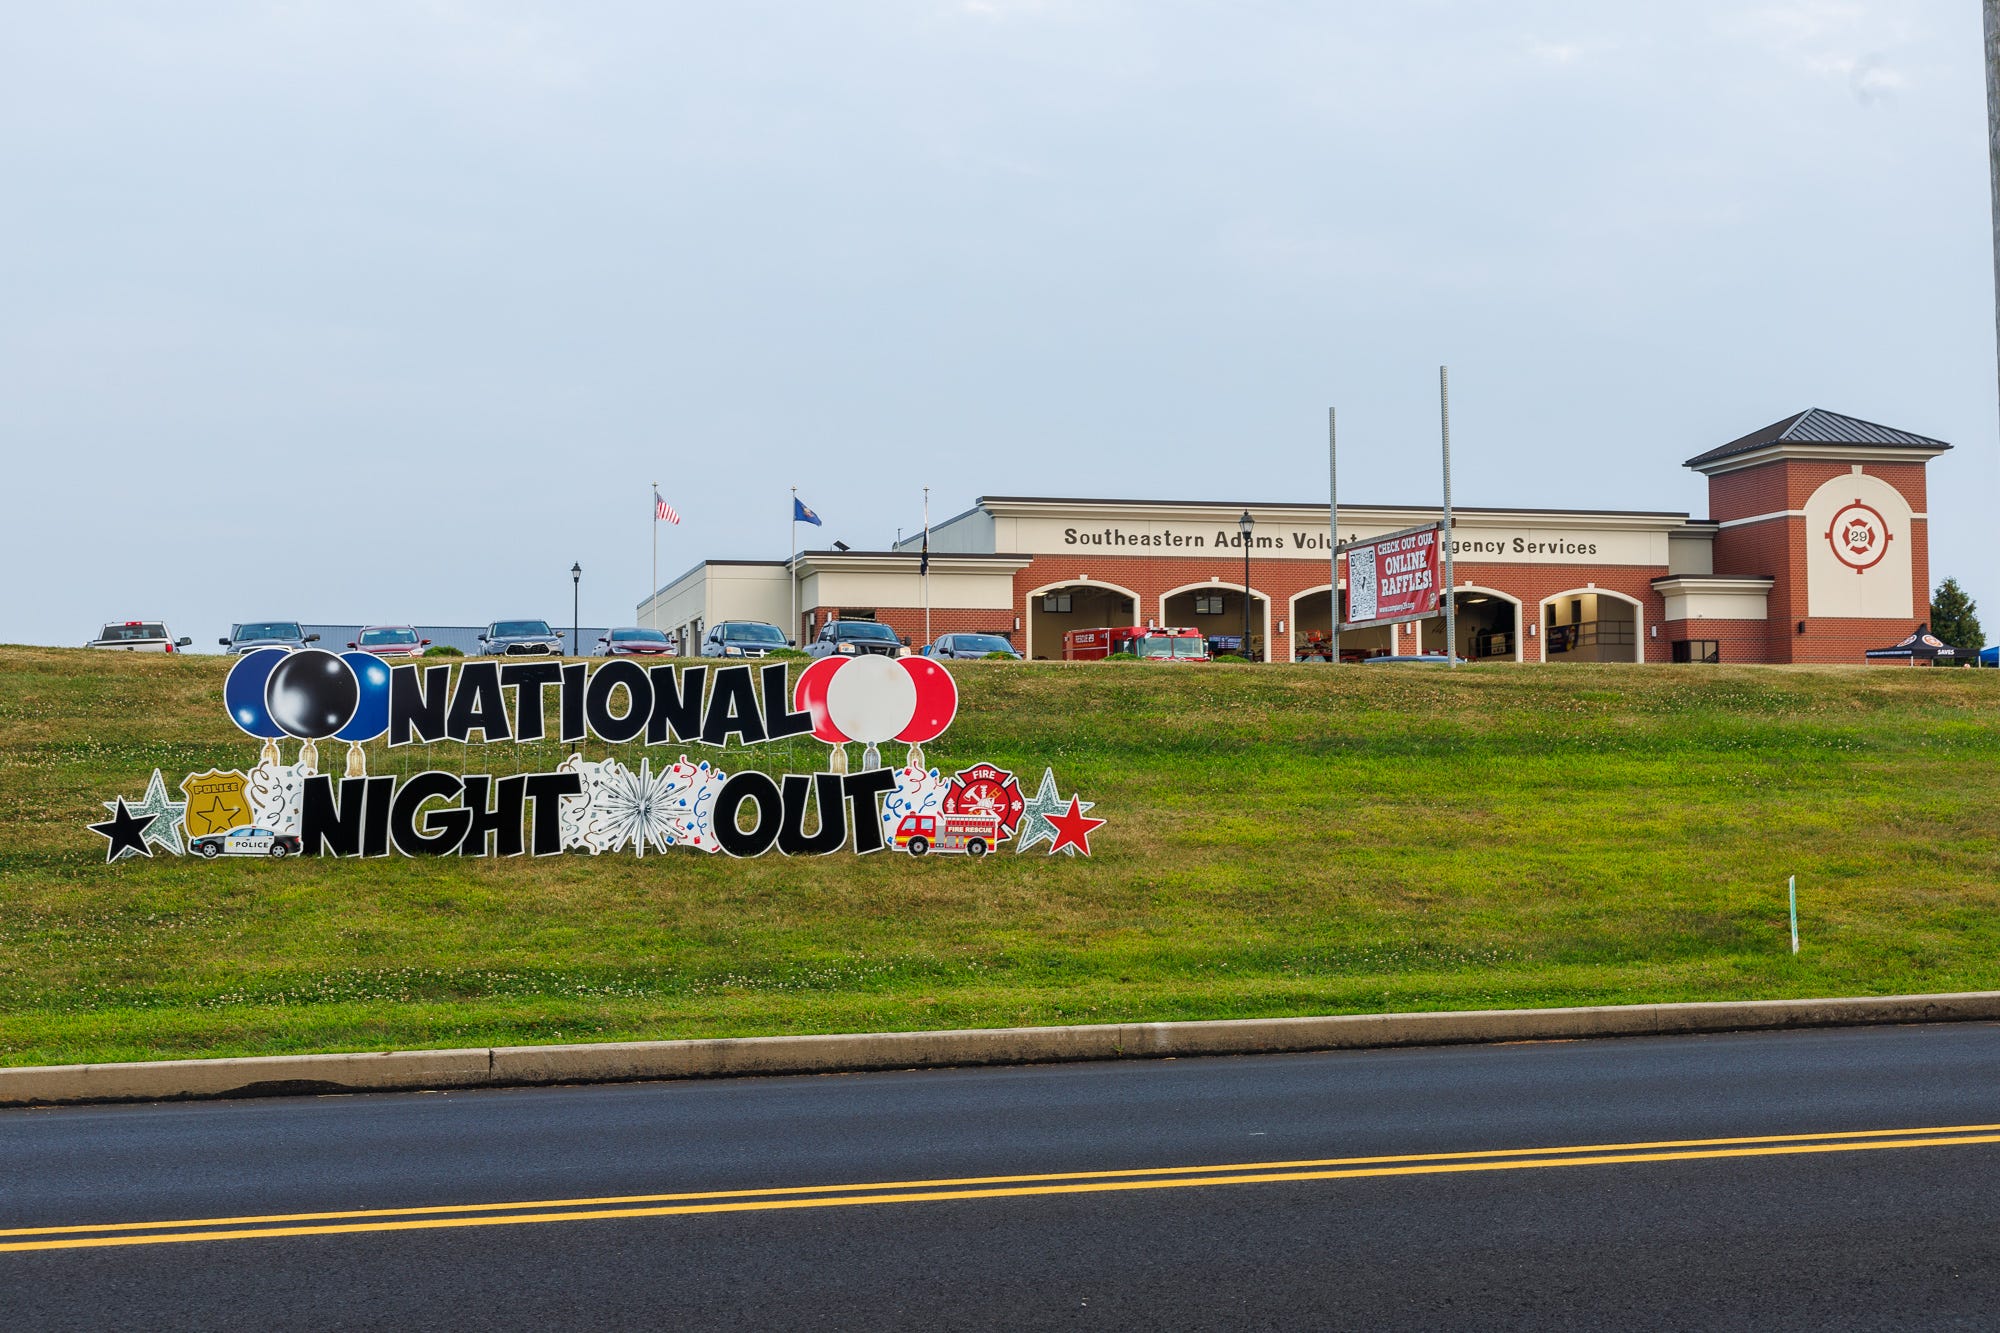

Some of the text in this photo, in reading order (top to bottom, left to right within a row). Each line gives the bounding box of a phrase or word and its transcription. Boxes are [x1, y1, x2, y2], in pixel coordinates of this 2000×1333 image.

[1064, 528, 1204, 547] Southeastern
[1214, 531, 1284, 548] Adams
[1512, 537, 1597, 554] Services
[1377, 532, 1434, 555] CHECK OUT OUR
[1851, 530, 1868, 542] 29
[1385, 550, 1427, 575] ONLINE
[1381, 569, 1432, 597] RAFFLES!
[387, 659, 817, 748] NATIONAL
[972, 769, 996, 780] FIRE
[193, 782, 239, 795] POLICE
[301, 767, 898, 859] NIGHT OUT
